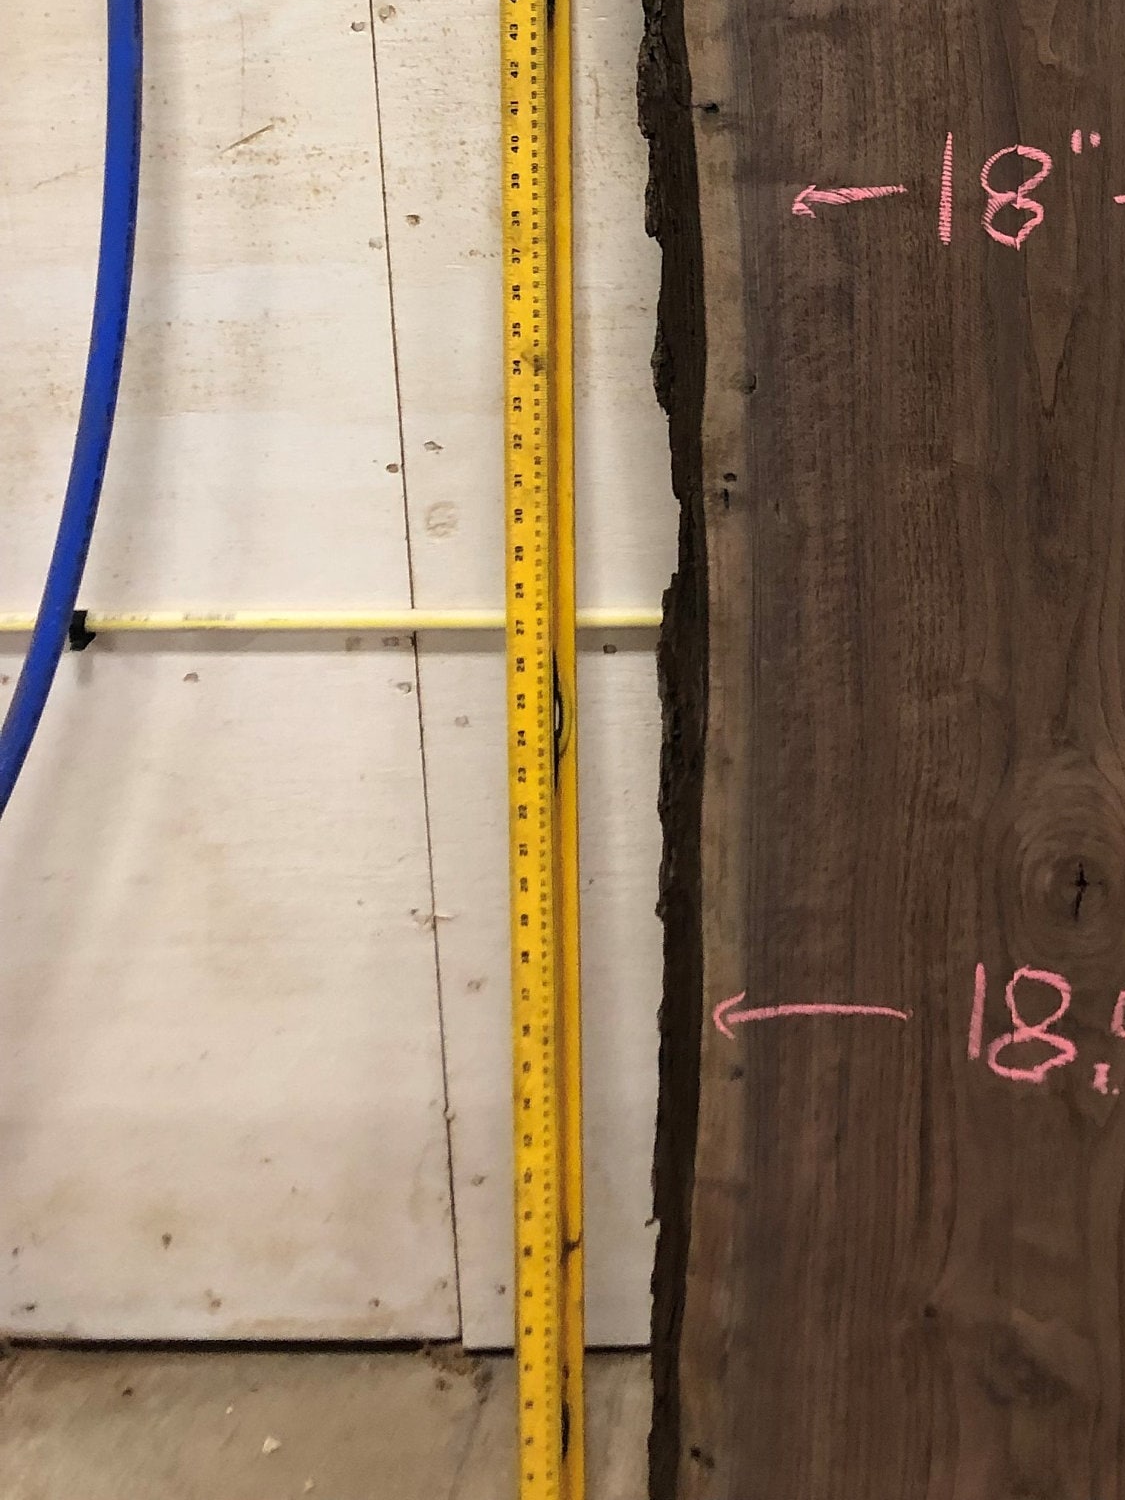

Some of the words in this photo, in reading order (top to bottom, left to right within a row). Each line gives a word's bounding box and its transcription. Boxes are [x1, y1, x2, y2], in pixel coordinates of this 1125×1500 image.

[509, 24, 518, 40] 43
[510, 61, 519, 78] 42
[510, 101, 519, 116] 41
[510, 135, 520, 153] 40
[511, 173, 520, 189] 39
[937, 129, 1102, 251] 18"
[511, 248, 520, 264] 37
[512, 284, 521, 301] 36
[512, 322, 521, 338] 35
[512, 360, 522, 376] 34
[513, 396, 522, 412] 33
[513, 433, 522, 450] 32
[513, 473, 522, 487] 31
[514, 508, 523, 524] 30
[514, 546, 524, 562] 29
[515, 583, 524, 599] 28
[515, 620, 524, 636] 27
[516, 657, 525, 673] 26
[516, 693, 526, 710] 25
[517, 730, 526, 747] 24
[517, 767, 526, 783] 23
[518, 804, 527, 820] 22
